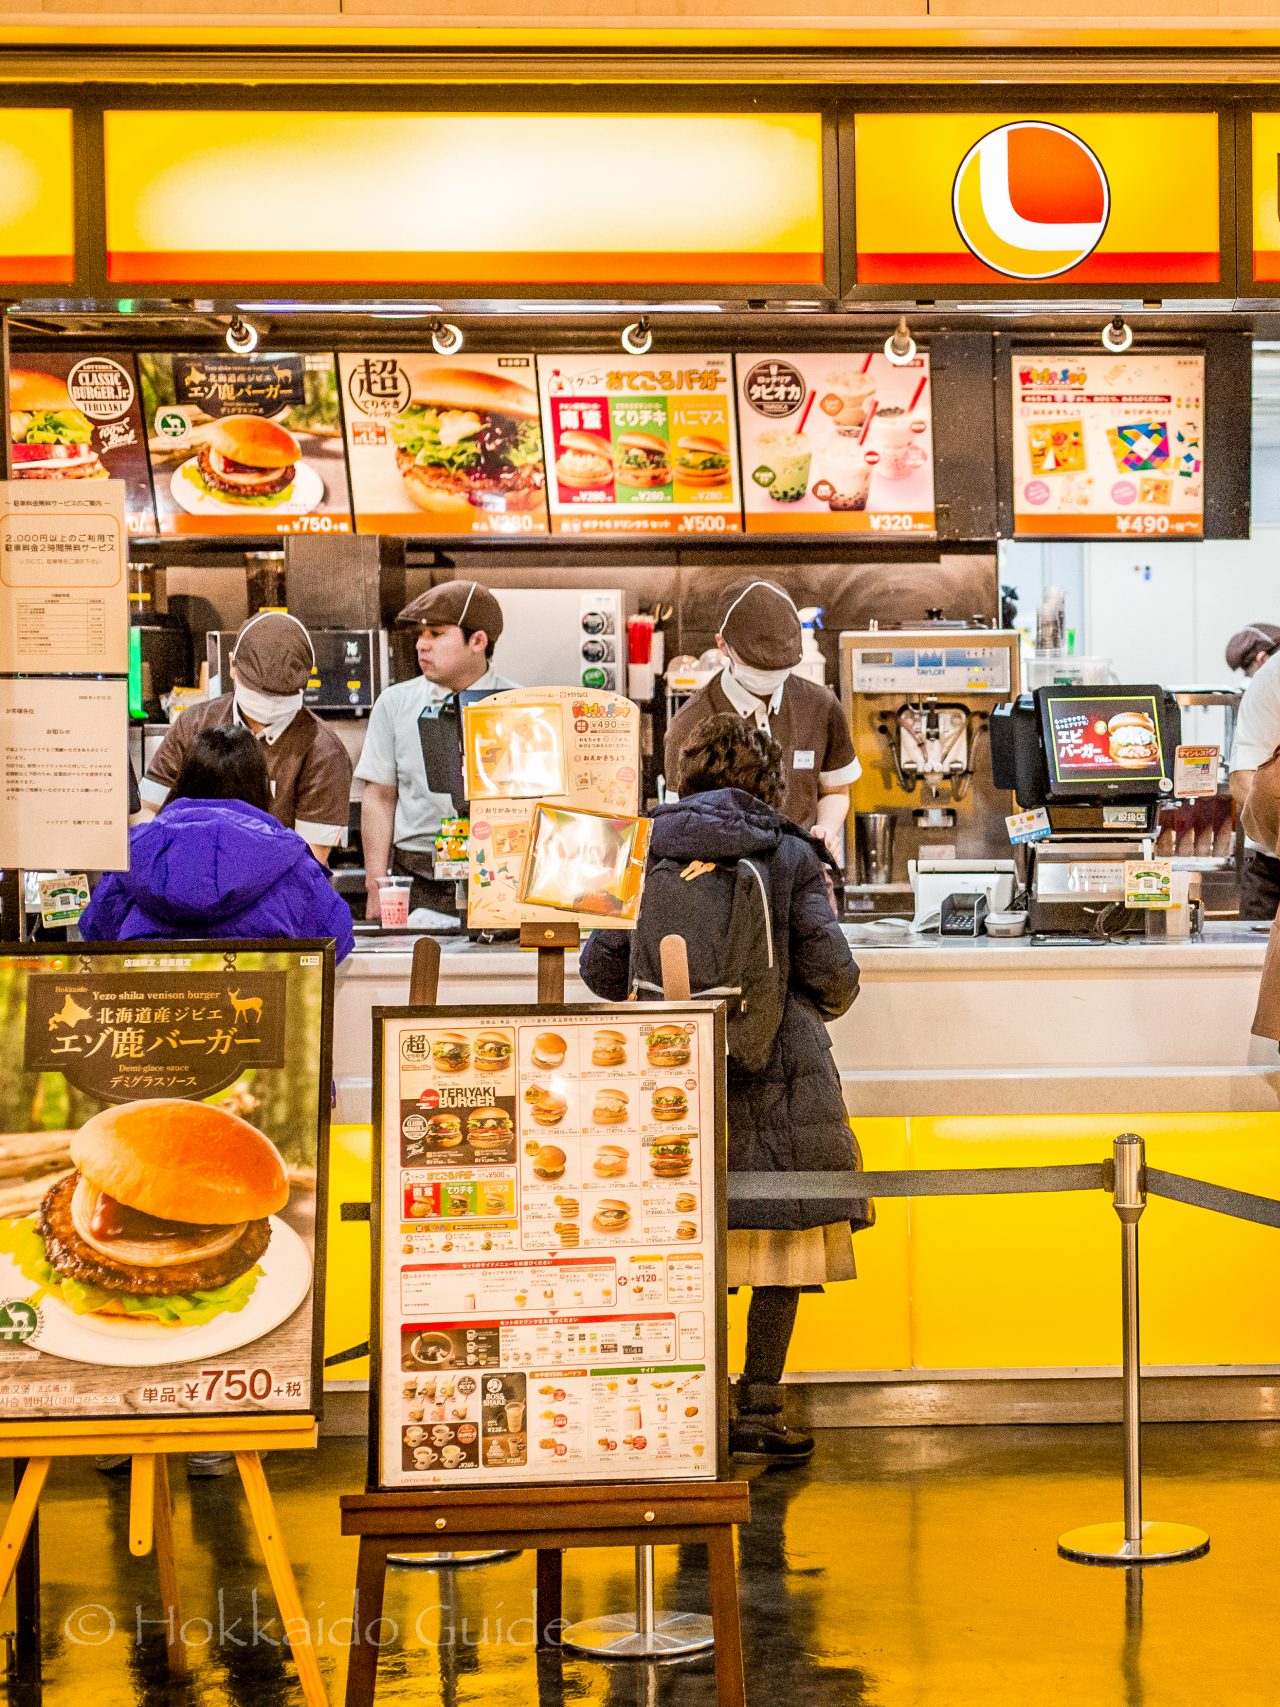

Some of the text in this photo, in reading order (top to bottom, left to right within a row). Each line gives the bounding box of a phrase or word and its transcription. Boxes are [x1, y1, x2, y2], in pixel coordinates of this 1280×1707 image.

[78, 372, 121, 386] CLASSIC
[357, 358, 400, 398] 超
[605, 369, 727, 391] おてごろバーガー
[188, 384, 293, 400] エゾ鹿バーガー
[750, 384, 800, 401] タピオカ
[84, 402, 122, 412] TERIYAKI
[362, 400, 400, 409] てりやき
[612, 410, 667, 428] てりチキ
[673, 409, 726, 426] ハニマス
[293, 516, 332, 532] ¥750
[682, 516, 726, 532] ¥500
[869, 514, 913, 530] ¥320
[1116, 516, 1170, 532] ¥490
[1058, 728, 1084, 744] エビ
[1060, 743, 1102, 758] バーガー
[93, 990, 221, 1002] Yezo shika venison burger
[96, 1006, 222, 1025] 北海道産ジビエ
[50, 1027, 262, 1059] エゾ鹿バーガー
[406, 1034, 426, 1054] 超
[118, 1064, 190, 1072] Demi-glace sauce
[110, 1075, 197, 1089] デミグラスソース
[438, 1086, 496, 1098] TERIYAKI
[438, 1096, 496, 1108] BURGER
[636, 1274, 658, 1283] ¥120
[142, 1387, 176, 1404] 単品
